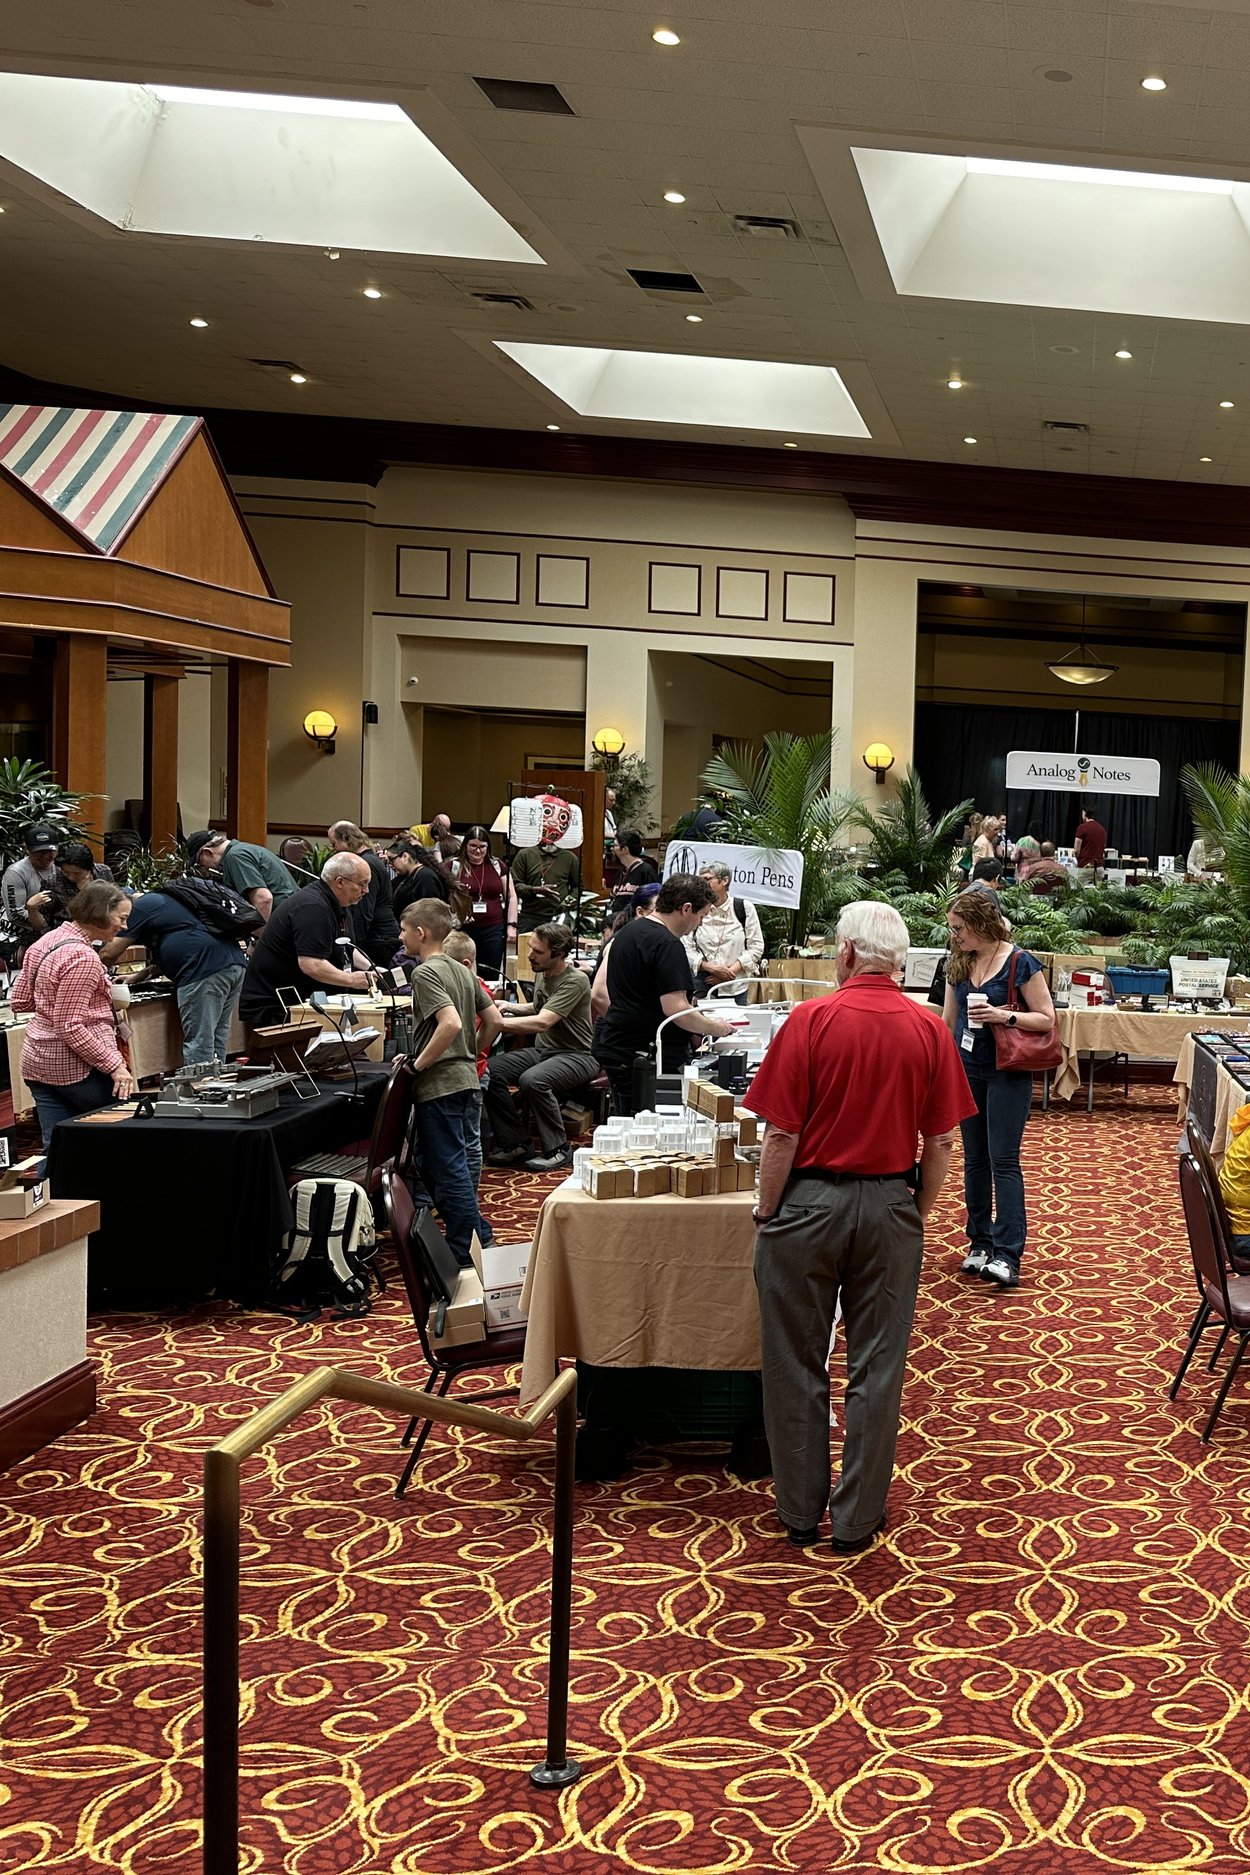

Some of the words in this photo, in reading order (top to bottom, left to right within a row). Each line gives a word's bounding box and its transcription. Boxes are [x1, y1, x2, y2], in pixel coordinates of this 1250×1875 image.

[1026, 763, 1076, 781] Analog
[1093, 766, 1131, 781] Notes
[761, 866, 794, 889] Pens
